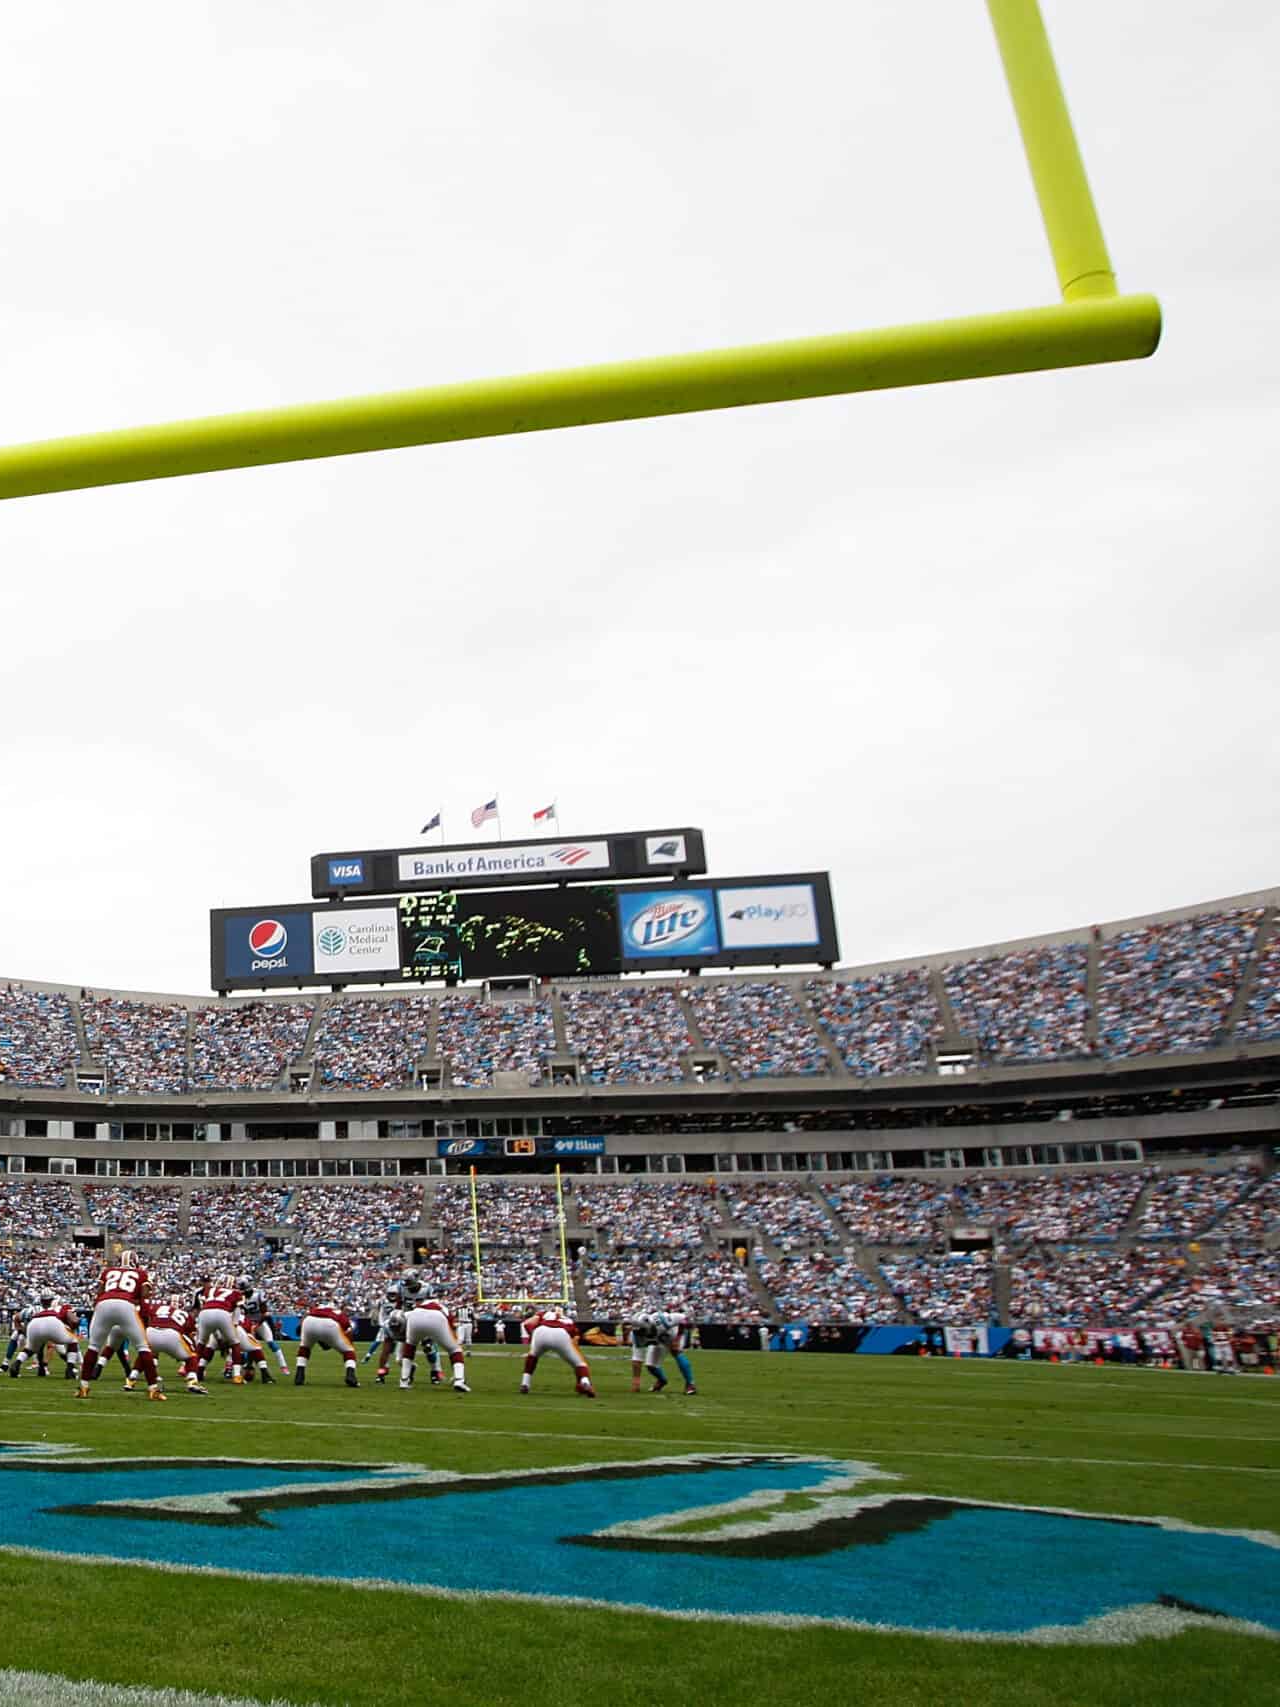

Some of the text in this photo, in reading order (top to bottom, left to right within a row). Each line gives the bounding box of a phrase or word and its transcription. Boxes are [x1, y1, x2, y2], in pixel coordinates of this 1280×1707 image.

[332, 865, 361, 878] VISA
[413, 855, 545, 876] Bank of America
[348, 921, 394, 934] Carolinas
[642, 909, 699, 946] Lite
[348, 934, 389, 945] Medical
[349, 945, 383, 955] Center
[251, 957, 287, 971] pepsi
[575, 1139, 603, 1150] Blue
[104, 1270, 138, 1293] 26
[206, 1287, 233, 1302] 17
